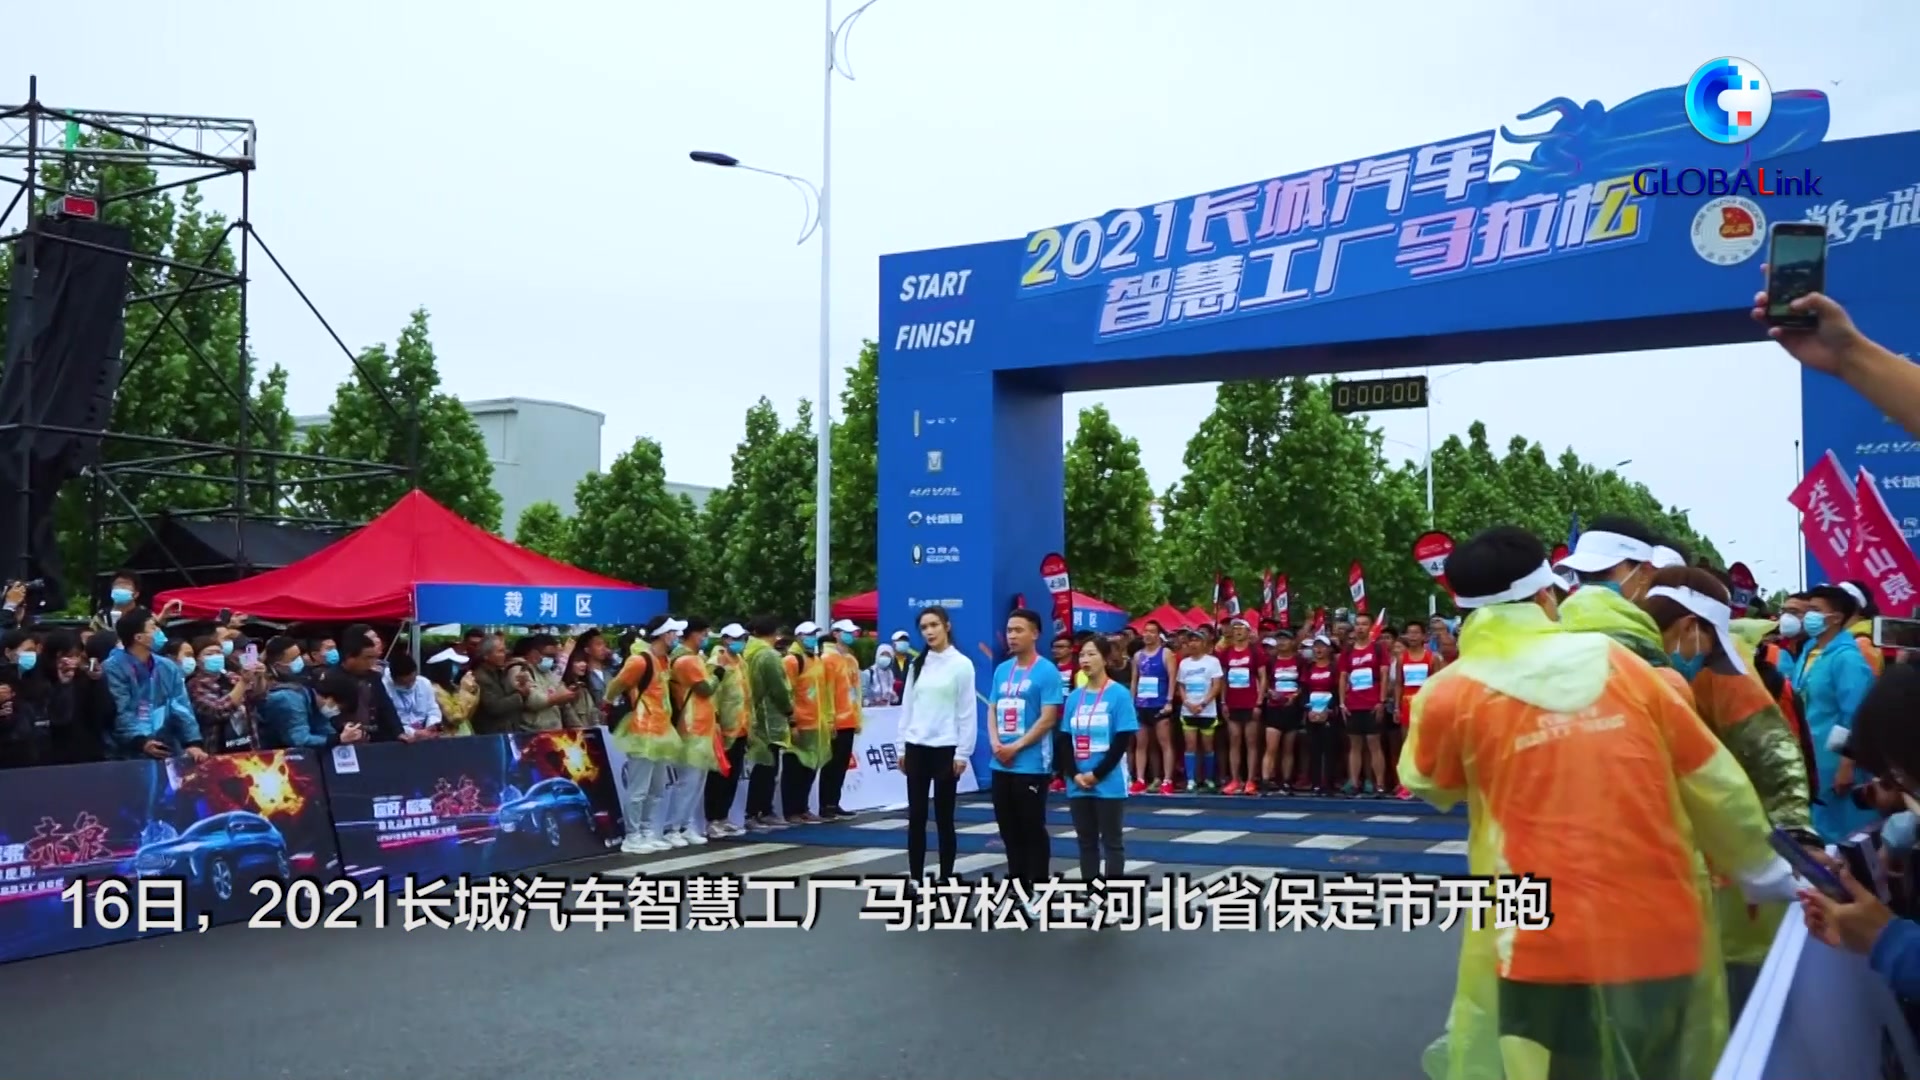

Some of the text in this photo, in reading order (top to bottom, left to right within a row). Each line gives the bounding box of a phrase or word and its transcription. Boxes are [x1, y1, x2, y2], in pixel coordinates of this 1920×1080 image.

[1021, 128, 1494, 287] 2021长城汽车
[1098, 174, 1647, 338] 智慧工厂马拉松
[899, 269, 972, 302] START
[895, 319, 976, 351] FINISH
[1337, 382, 1420, 406] 0:00:00
[504, 591, 593, 618] 裁判区
[866, 743, 898, 773] 中国
